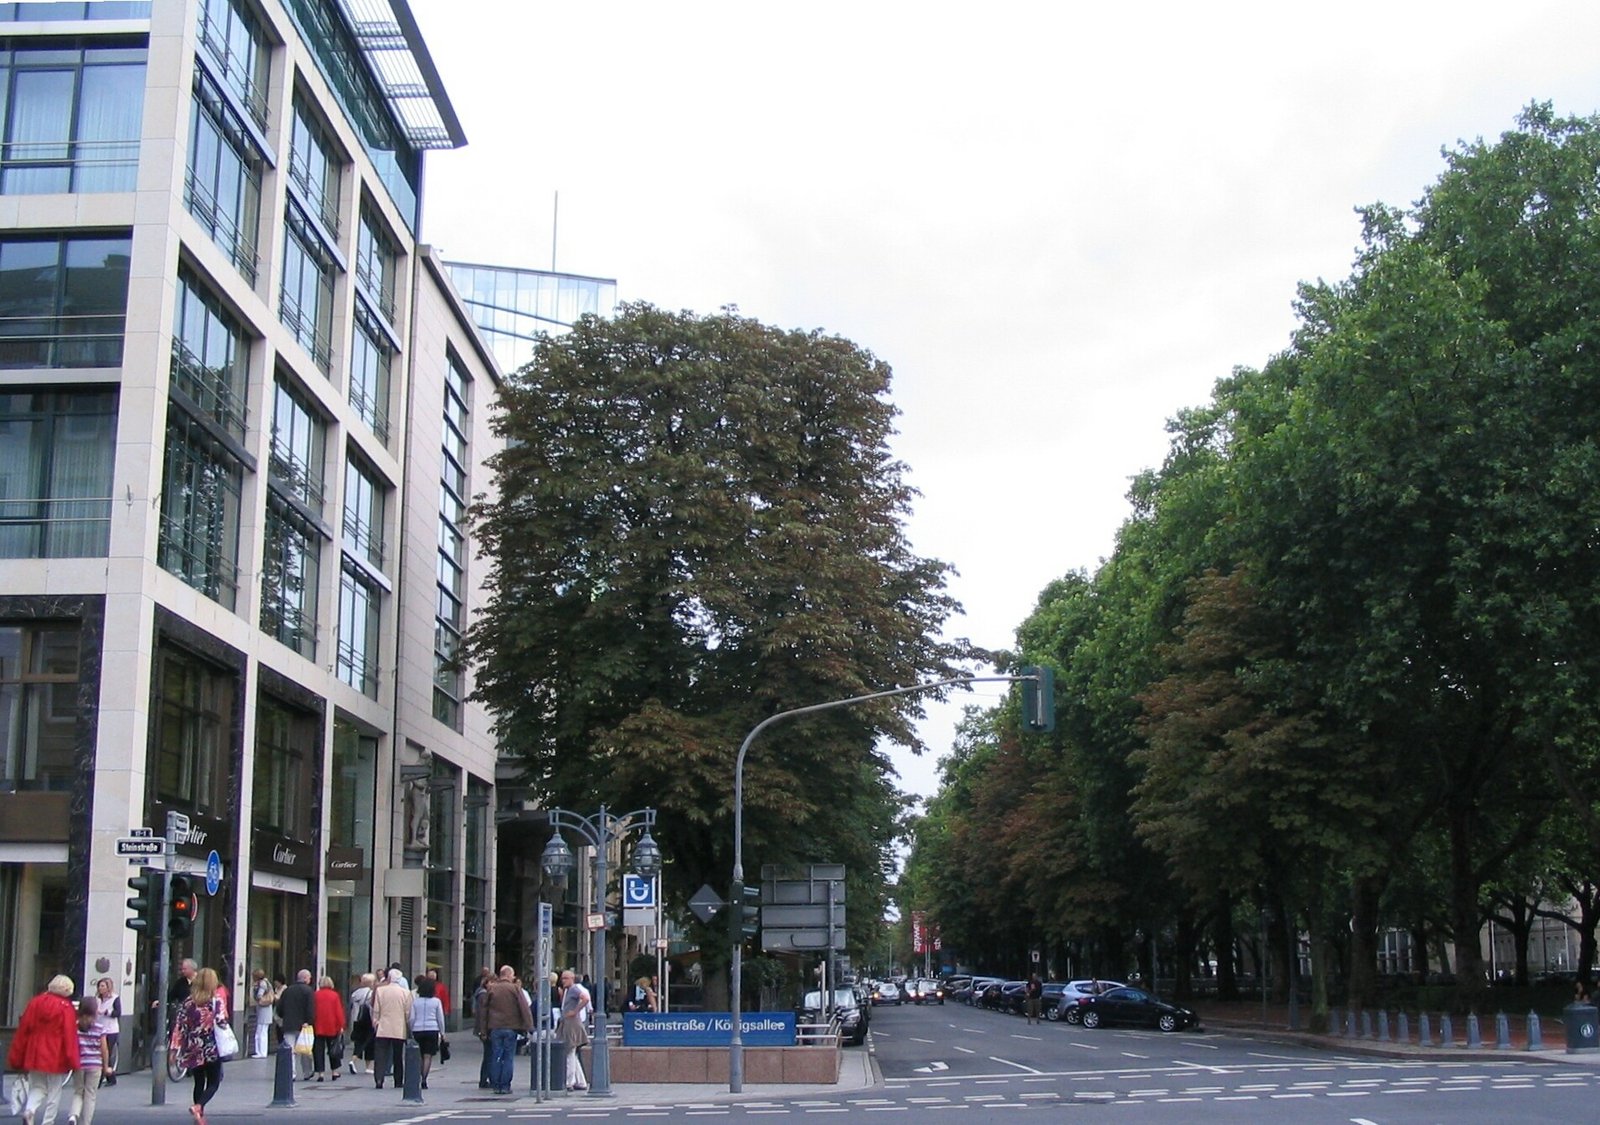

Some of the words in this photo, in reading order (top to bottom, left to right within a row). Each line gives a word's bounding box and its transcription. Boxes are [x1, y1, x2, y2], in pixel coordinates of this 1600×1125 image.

[185, 824, 208, 845] rtier
[121, 842, 158, 853] Steinstraße
[273, 842, 297, 865] Cartier
[331, 860, 358, 869] Cartier
[633, 1019, 706, 1031] Steinstraße
[715, 1019, 785, 1033] Köigsallee
